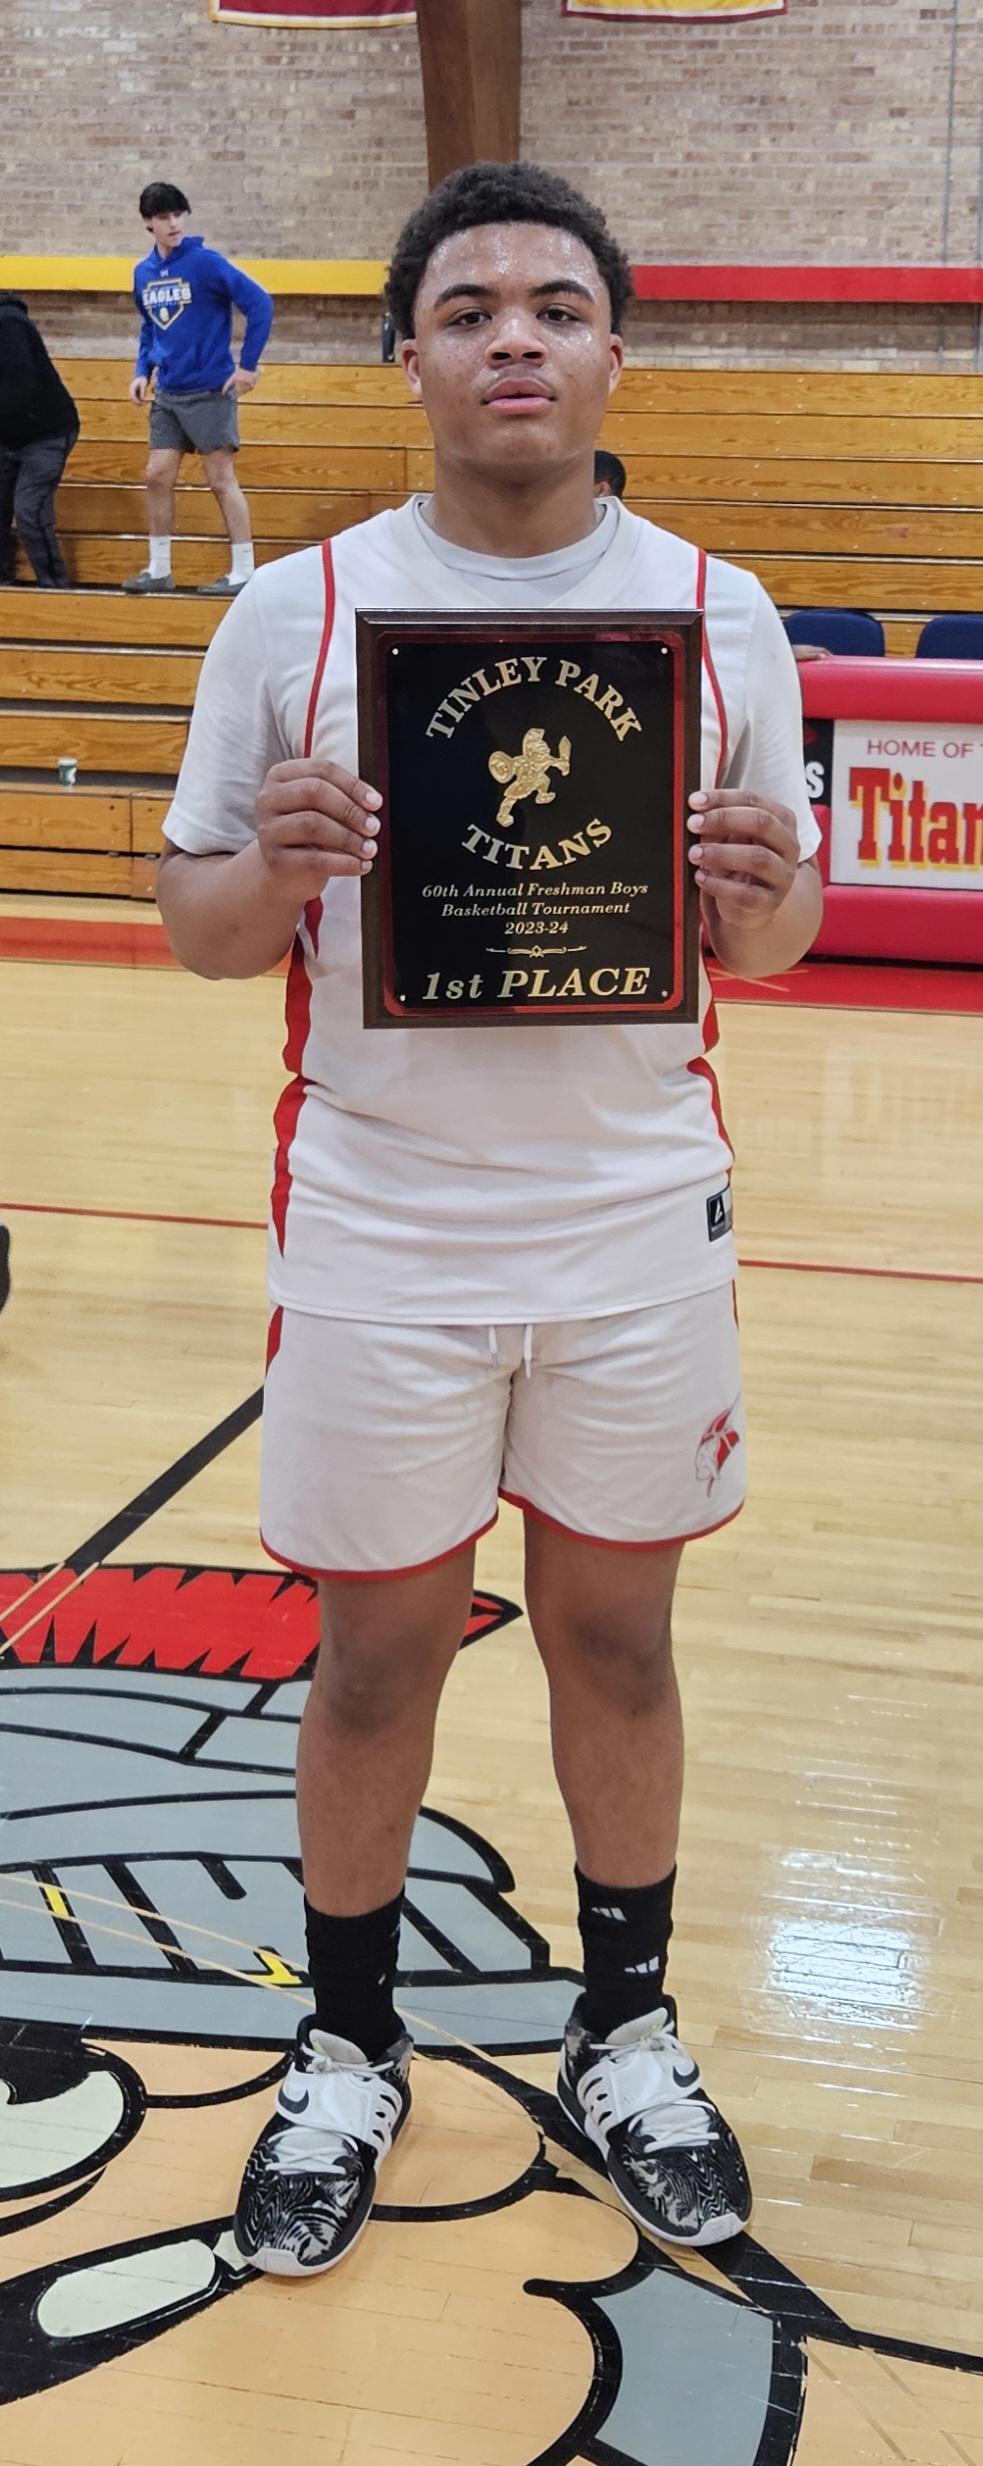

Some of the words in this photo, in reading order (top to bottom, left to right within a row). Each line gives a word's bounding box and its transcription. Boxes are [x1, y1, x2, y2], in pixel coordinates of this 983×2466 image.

[426, 656, 547, 739] TINLEY
[555, 659, 642, 741] PARK
[867, 739, 935, 757] HOME
[942, 742, 974, 758] OF
[462, 818, 612, 870] TITANS
[422, 884, 459, 898] 60th
[463, 883, 523, 897] Annual
[527, 882, 606, 896] Freshman
[610, 881, 648, 897] Boys
[441, 902, 527, 917] Basketball
[531, 901, 631, 916] Tournament
[504, 921, 570, 935] 2023-24
[422, 972, 484, 1000] 1st
[497, 967, 651, 998] PLACE
